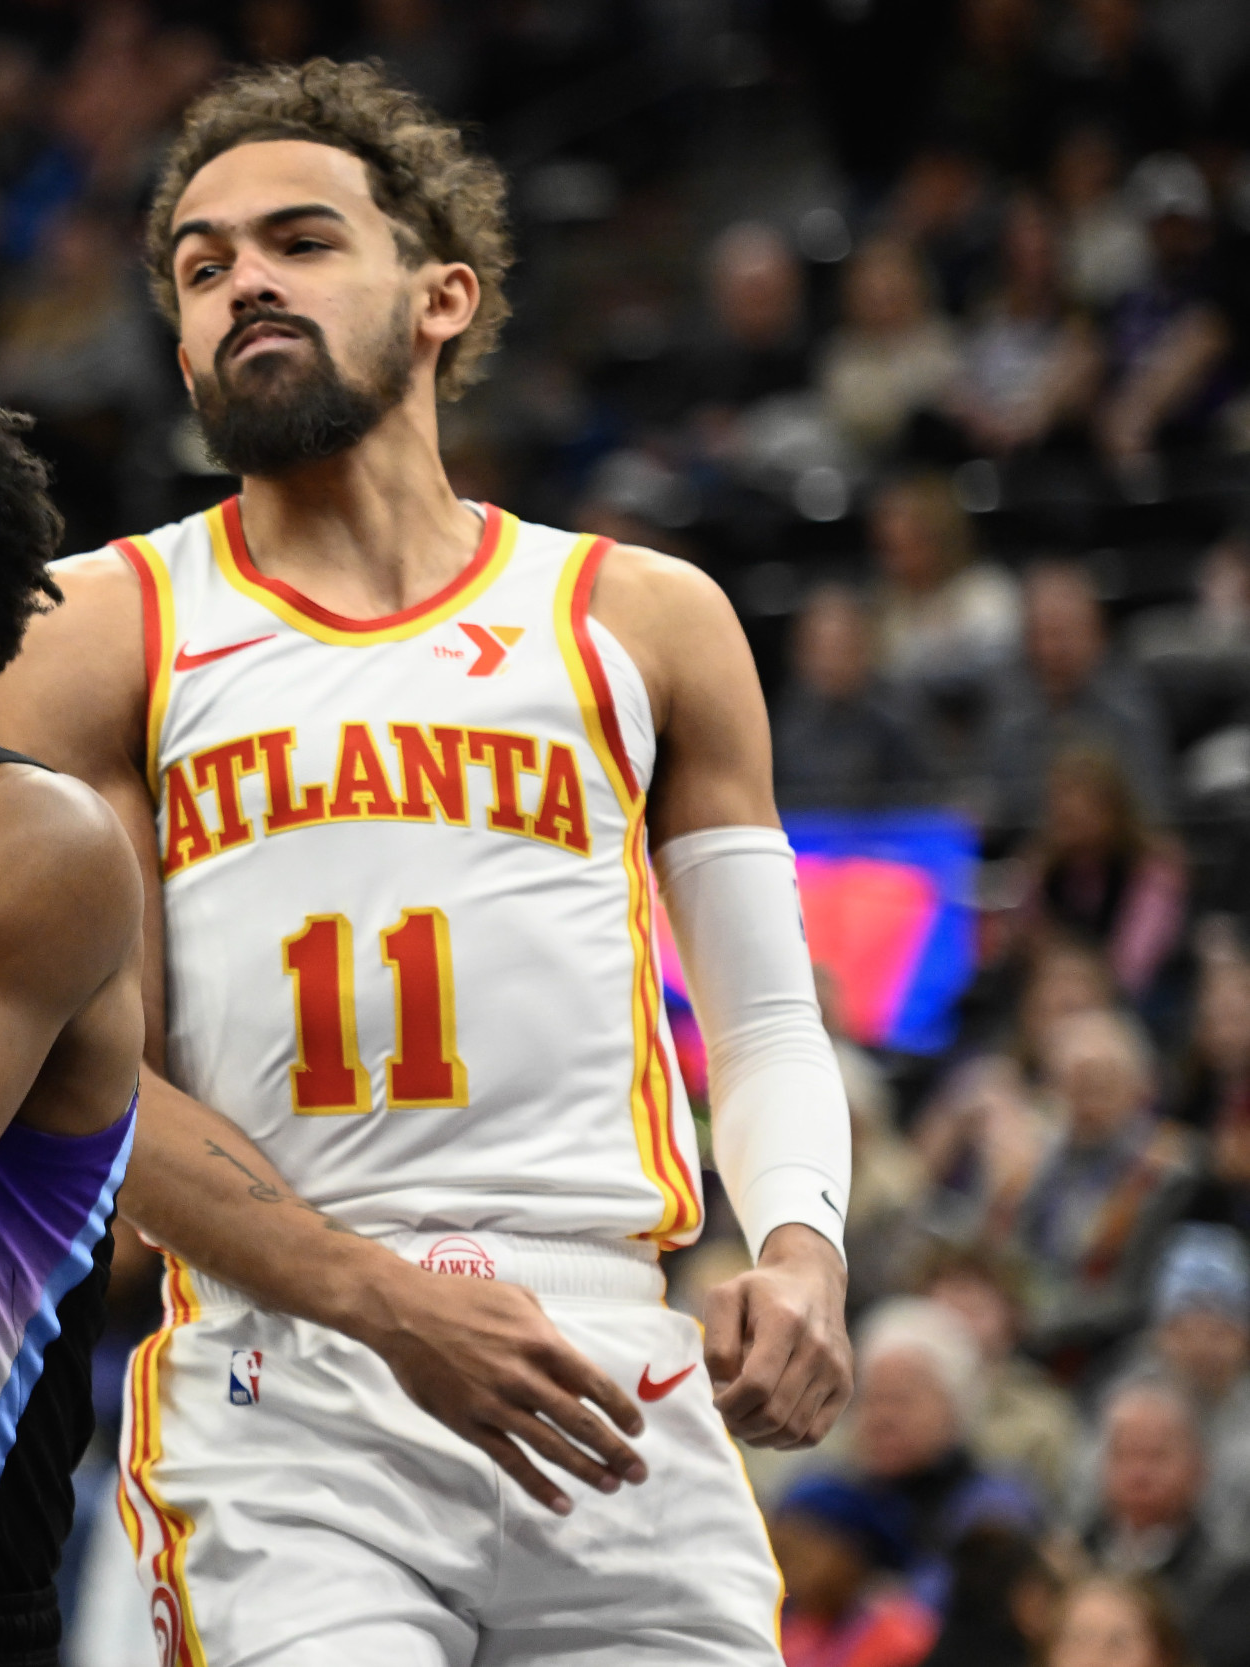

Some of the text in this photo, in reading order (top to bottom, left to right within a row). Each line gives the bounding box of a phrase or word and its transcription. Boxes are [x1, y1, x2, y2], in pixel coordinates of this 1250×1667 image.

[433, 645, 465, 660] the
[161, 721, 592, 881] ATLANTA
[281, 906, 469, 1116] 11
